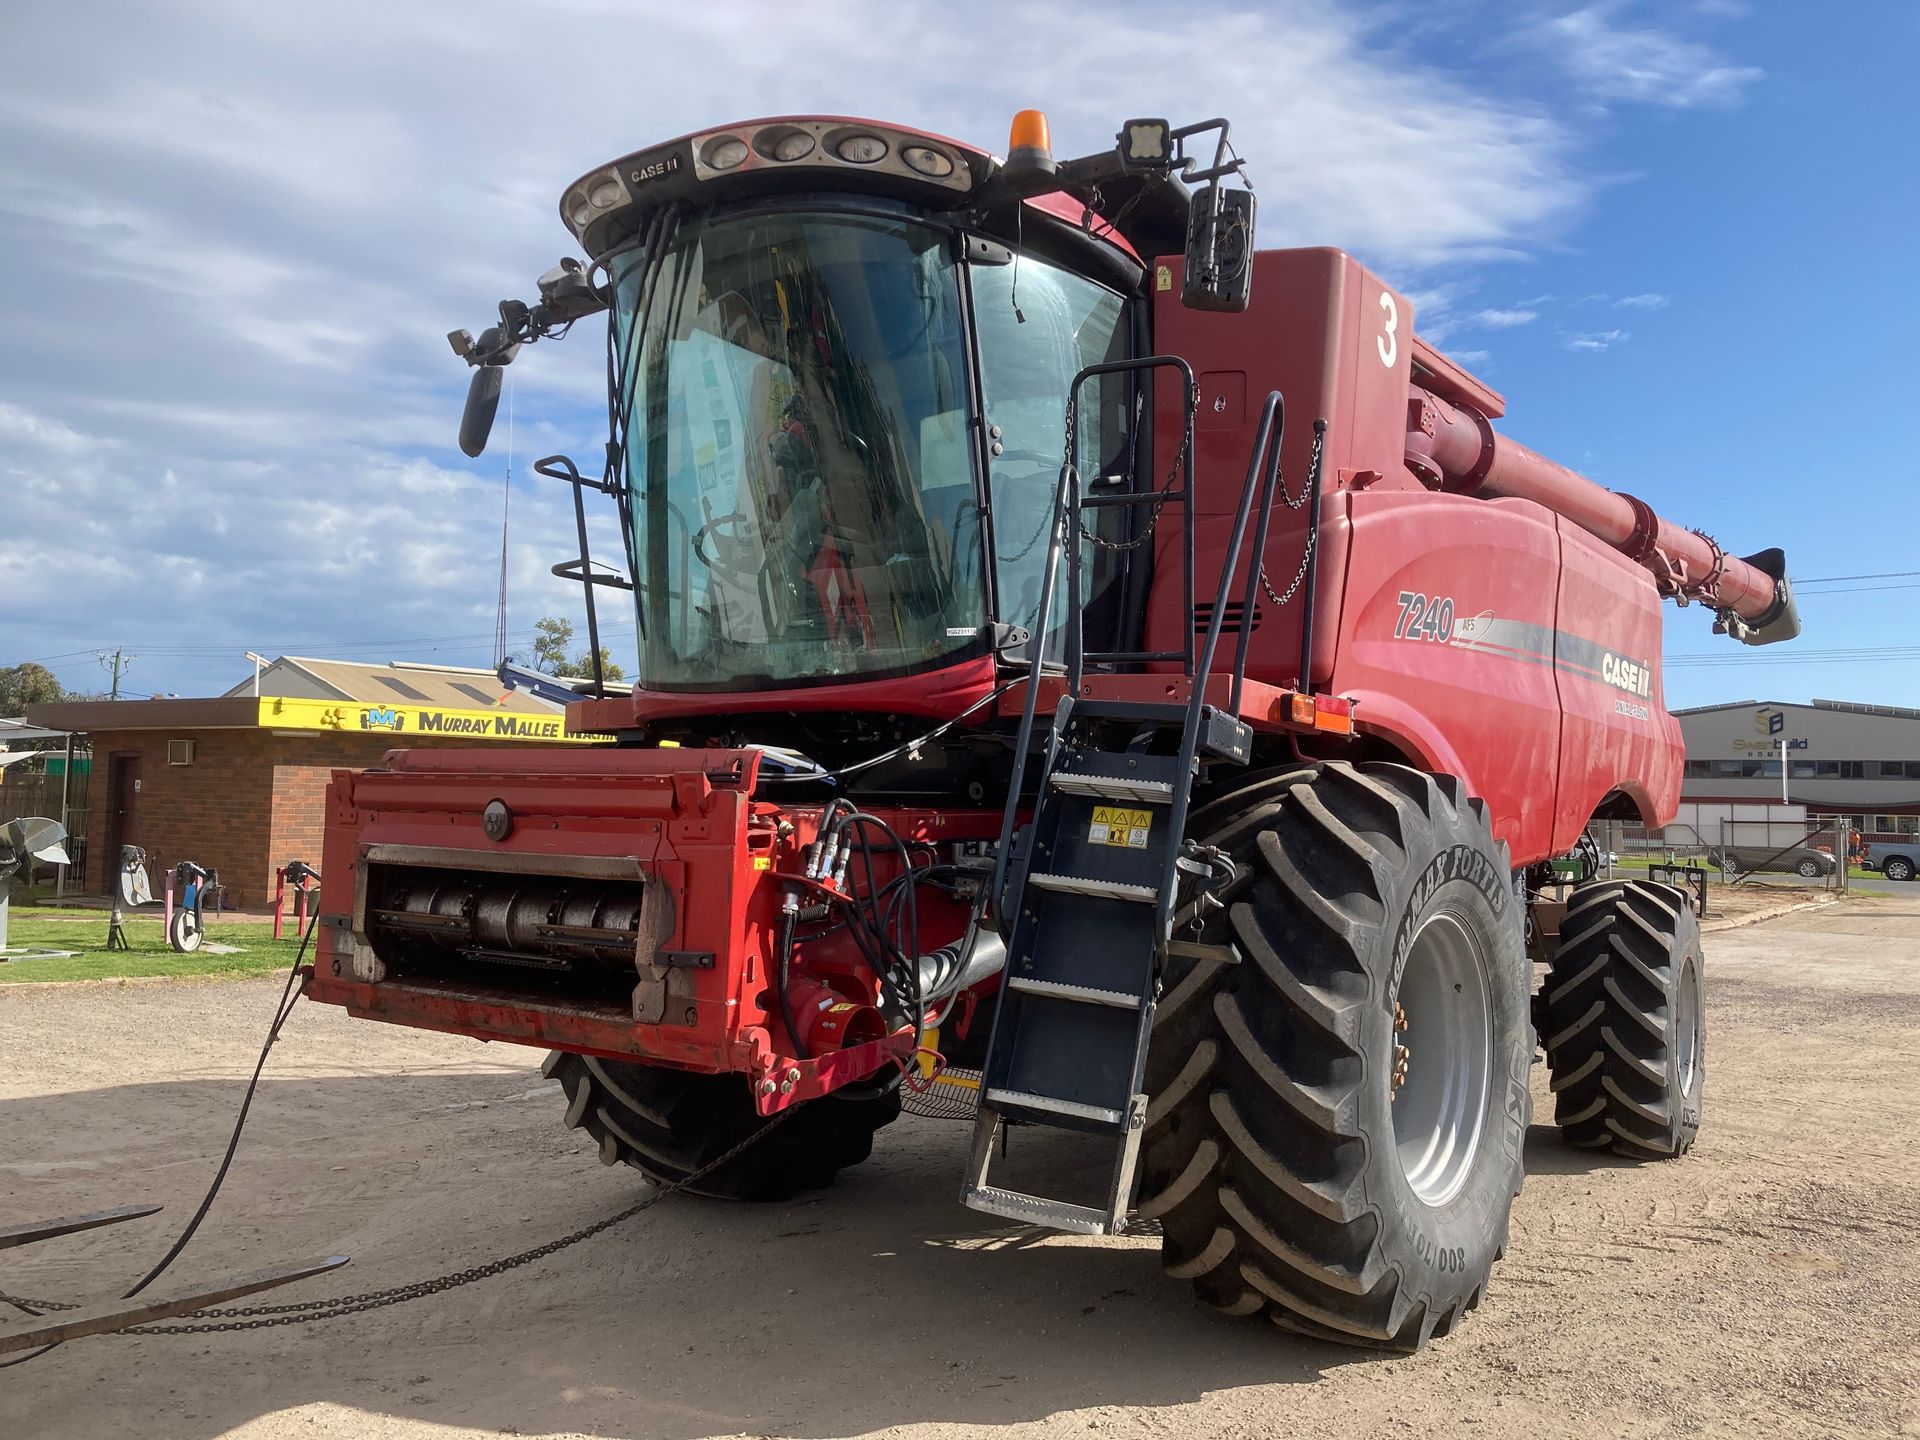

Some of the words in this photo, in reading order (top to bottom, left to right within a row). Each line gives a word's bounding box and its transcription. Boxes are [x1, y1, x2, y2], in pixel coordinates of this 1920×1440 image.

[631, 163, 664, 183] CASE
[1377, 291, 1397, 368] 3
[1394, 590, 1455, 643] 7240
[1602, 653, 1638, 693] CASE
[419, 711, 492, 734] MURRAY
[495, 716, 560, 738] MALLEE
[1450, 847, 1506, 914] FORTIS
